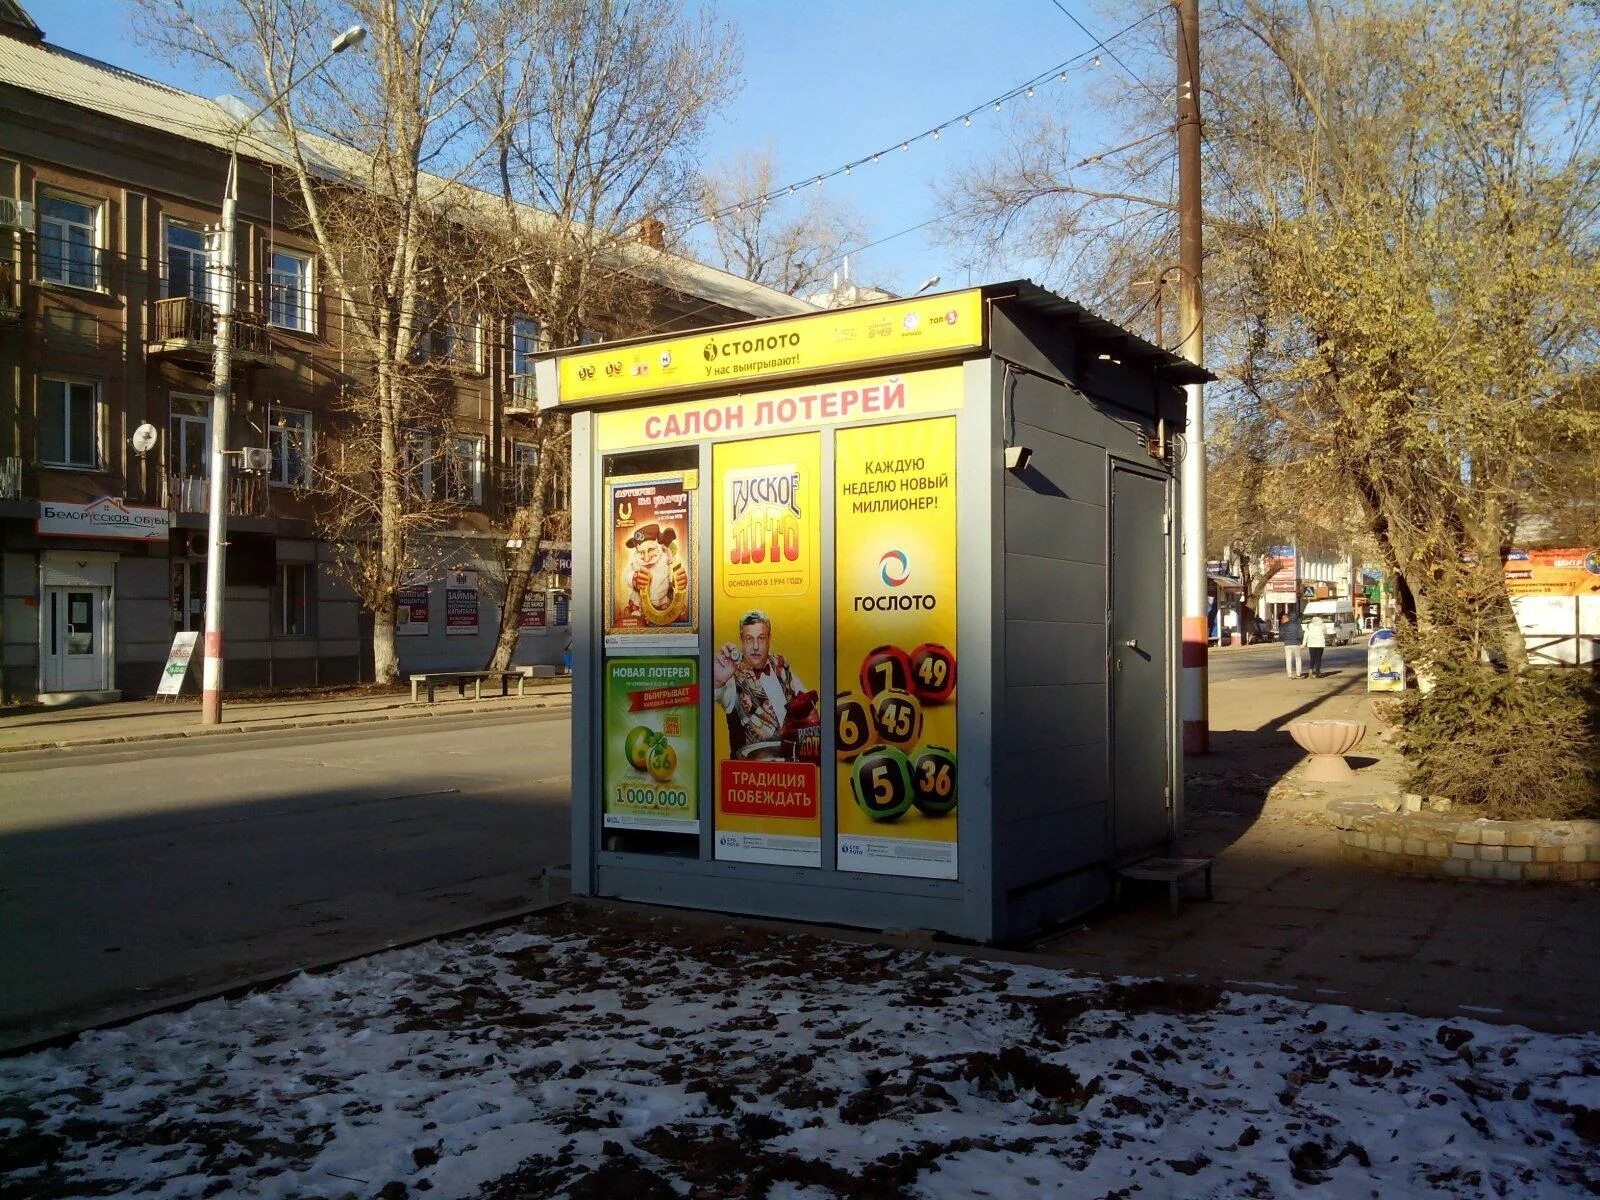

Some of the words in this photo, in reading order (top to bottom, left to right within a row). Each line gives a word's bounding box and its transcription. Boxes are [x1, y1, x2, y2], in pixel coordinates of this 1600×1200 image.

[721, 332, 800, 357] СТОЛОТО
[714, 366, 730, 376] нас
[733, 353, 800, 373] выигрывают!
[645, 405, 744, 440] САЛОН
[754, 377, 905, 426] ЛОТЕРЕЙ
[865, 457, 925, 475] КАЖДУЮ
[843, 479, 897, 496] НЕДЕЛЮ
[900, 473, 949, 491] НОВЫЙ
[732, 474, 801, 521] РУССКОЕ
[852, 496, 938, 514] МИЛЛИОНЕР!
[730, 507, 799, 565] ЛОТО
[728, 580, 763, 588] ОСНОВАНО
[786, 577, 803, 585] ГОДУ
[448, 591, 477, 600] ЗАЙМЫ
[853, 594, 936, 612] ГОСЛОТО
[612, 667, 646, 678] НОВАЯ
[648, 667, 690, 678] ЛОТЕРЕЯ
[874, 660, 893, 692] 7
[918, 657, 947, 687] 49
[643, 687, 690, 701] ВЫИГРЫВАЕТ
[838, 709, 859, 745] 6
[881, 704, 912, 737] 45
[732, 771, 806, 788] ТРАДИЦИЯ
[871, 765, 894, 805] 5
[919, 759, 951, 796] 36
[626, 788, 655, 805] 000
[658, 790, 687, 807] 000
[728, 789, 812, 807] ПОБЕЖДАТЬ
